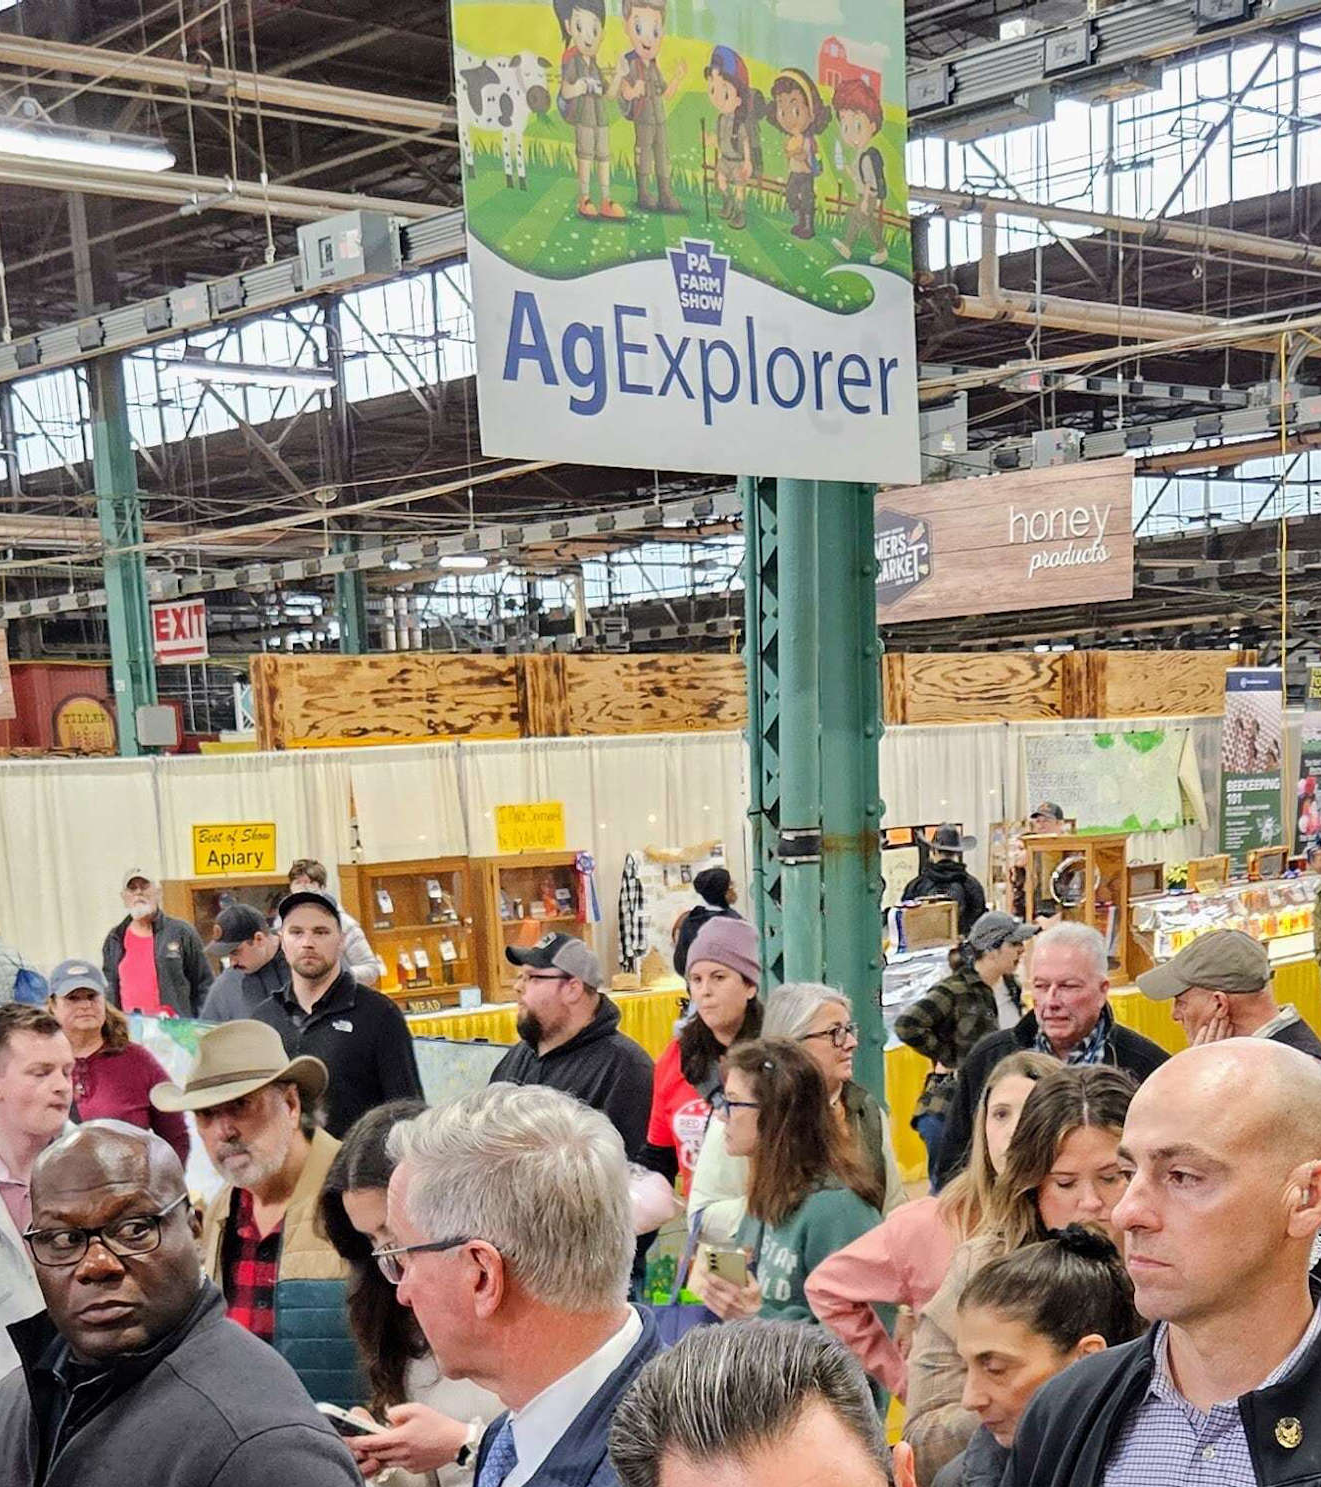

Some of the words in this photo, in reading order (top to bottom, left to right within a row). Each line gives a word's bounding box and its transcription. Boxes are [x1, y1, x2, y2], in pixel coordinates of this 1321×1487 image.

[687, 252, 712, 273] PA
[679, 272, 721, 293] FARM
[680, 291, 724, 311] SHOW
[503, 290, 898, 425] AgExplorer
[1009, 503, 1112, 546] honey
[875, 532, 907, 561] MERS
[1028, 543, 1112, 579] products
[154, 604, 205, 641] EXIT
[1225, 777, 1280, 792] BEEKEEPING
[198, 828, 224, 843] Best
[241, 828, 271, 843] Show
[207, 848, 264, 870] Apiary
[409, 999, 441, 1012] MEAD
